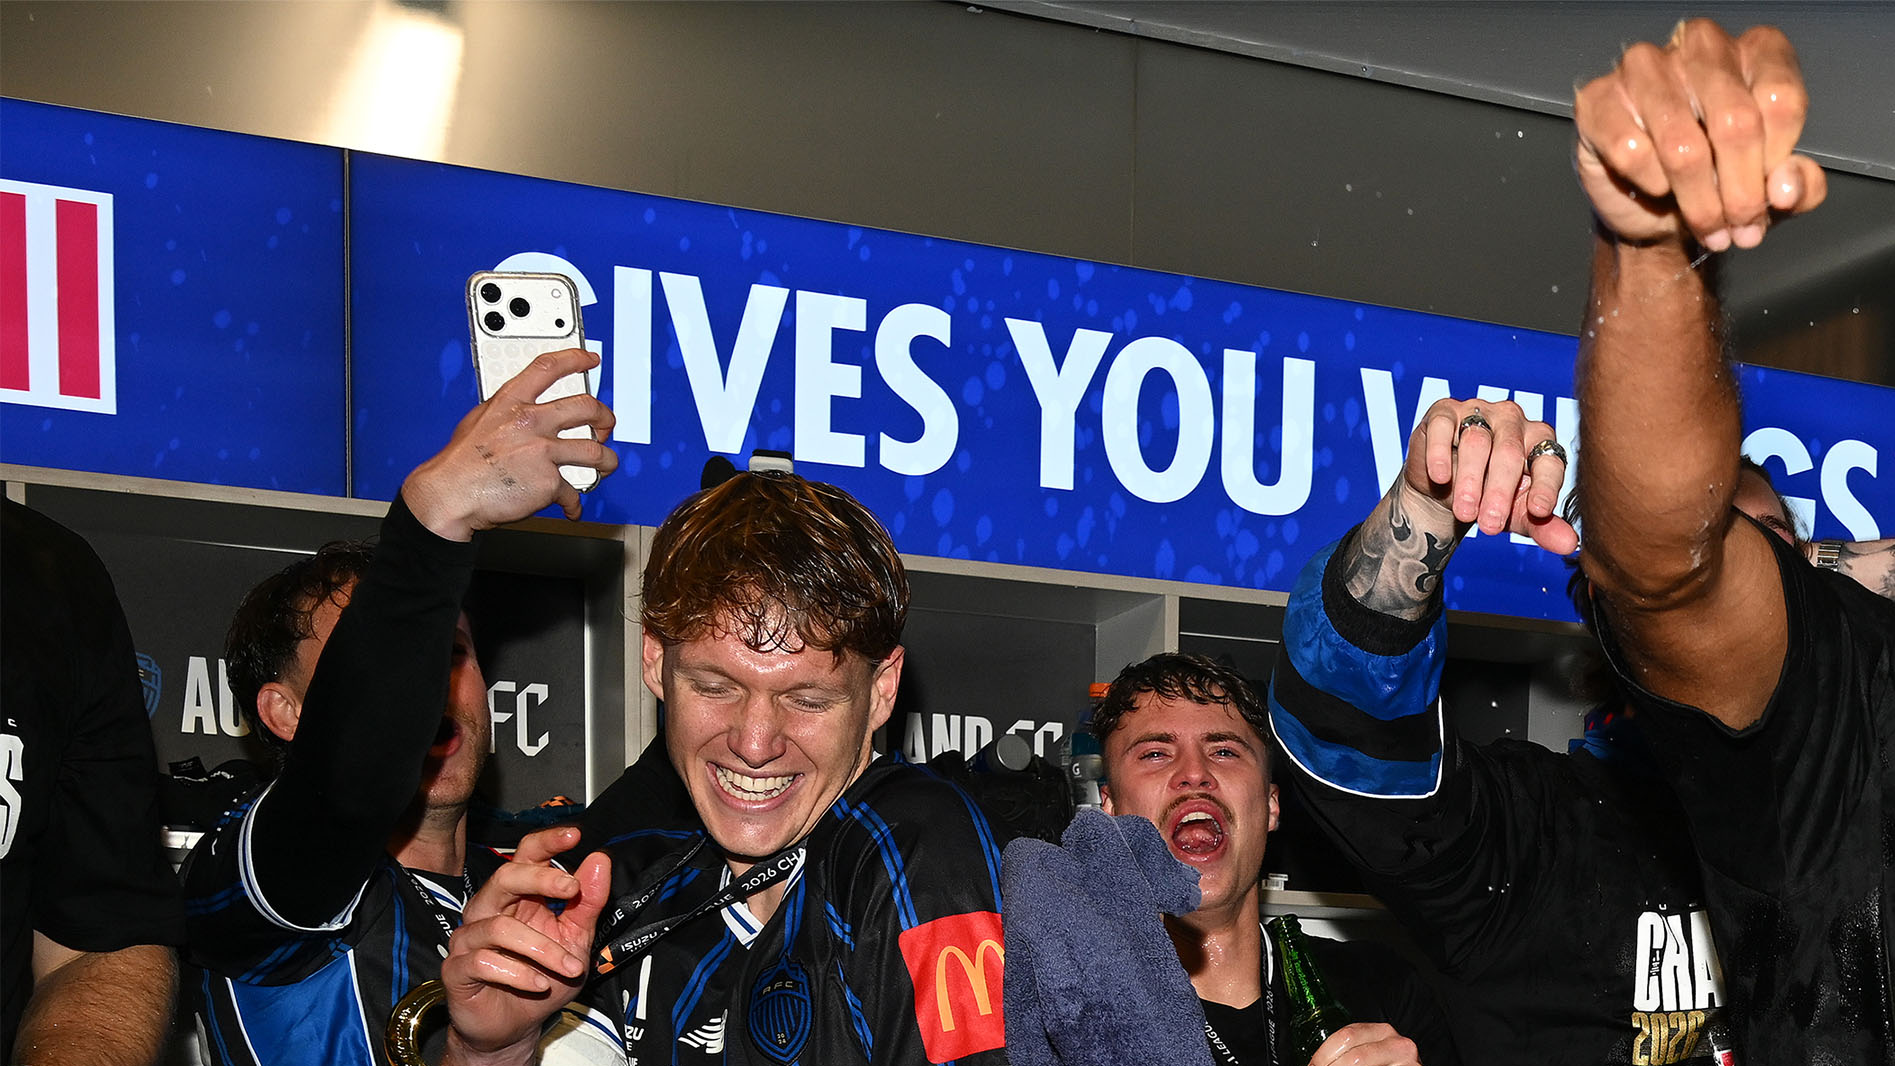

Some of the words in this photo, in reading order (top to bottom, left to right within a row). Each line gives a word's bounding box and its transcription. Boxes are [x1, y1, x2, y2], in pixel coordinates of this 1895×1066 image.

[1005, 317, 1318, 517] YOU
[741, 868, 777, 892] 2026
[1204, 1021, 1231, 1055] LEAGU
